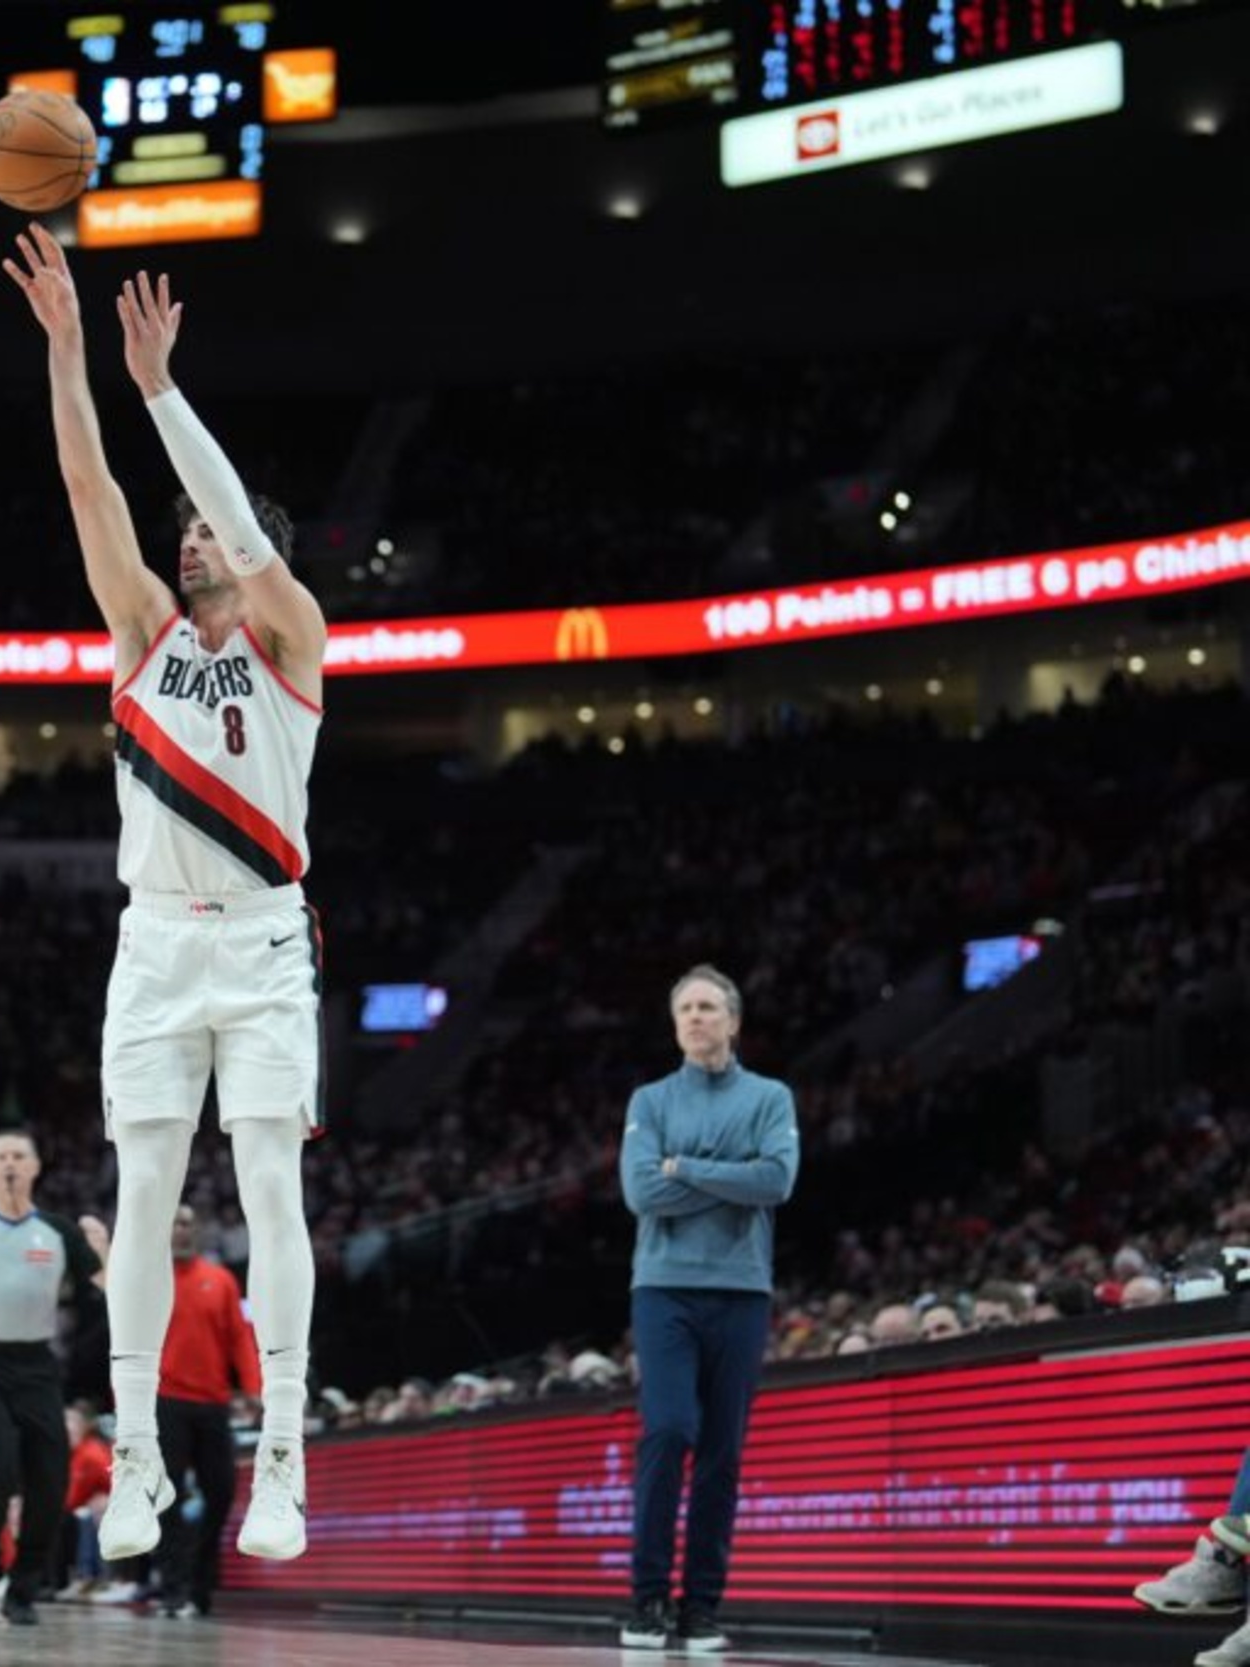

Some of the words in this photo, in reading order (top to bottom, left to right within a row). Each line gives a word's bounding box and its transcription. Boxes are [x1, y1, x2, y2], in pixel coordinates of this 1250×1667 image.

[704, 598, 772, 640] 100
[774, 583, 892, 632] Points
[931, 562, 1035, 611] FREE
[1040, 559, 1069, 595] 6
[322, 626, 465, 664] urchase
[221, 704, 246, 756] 8
